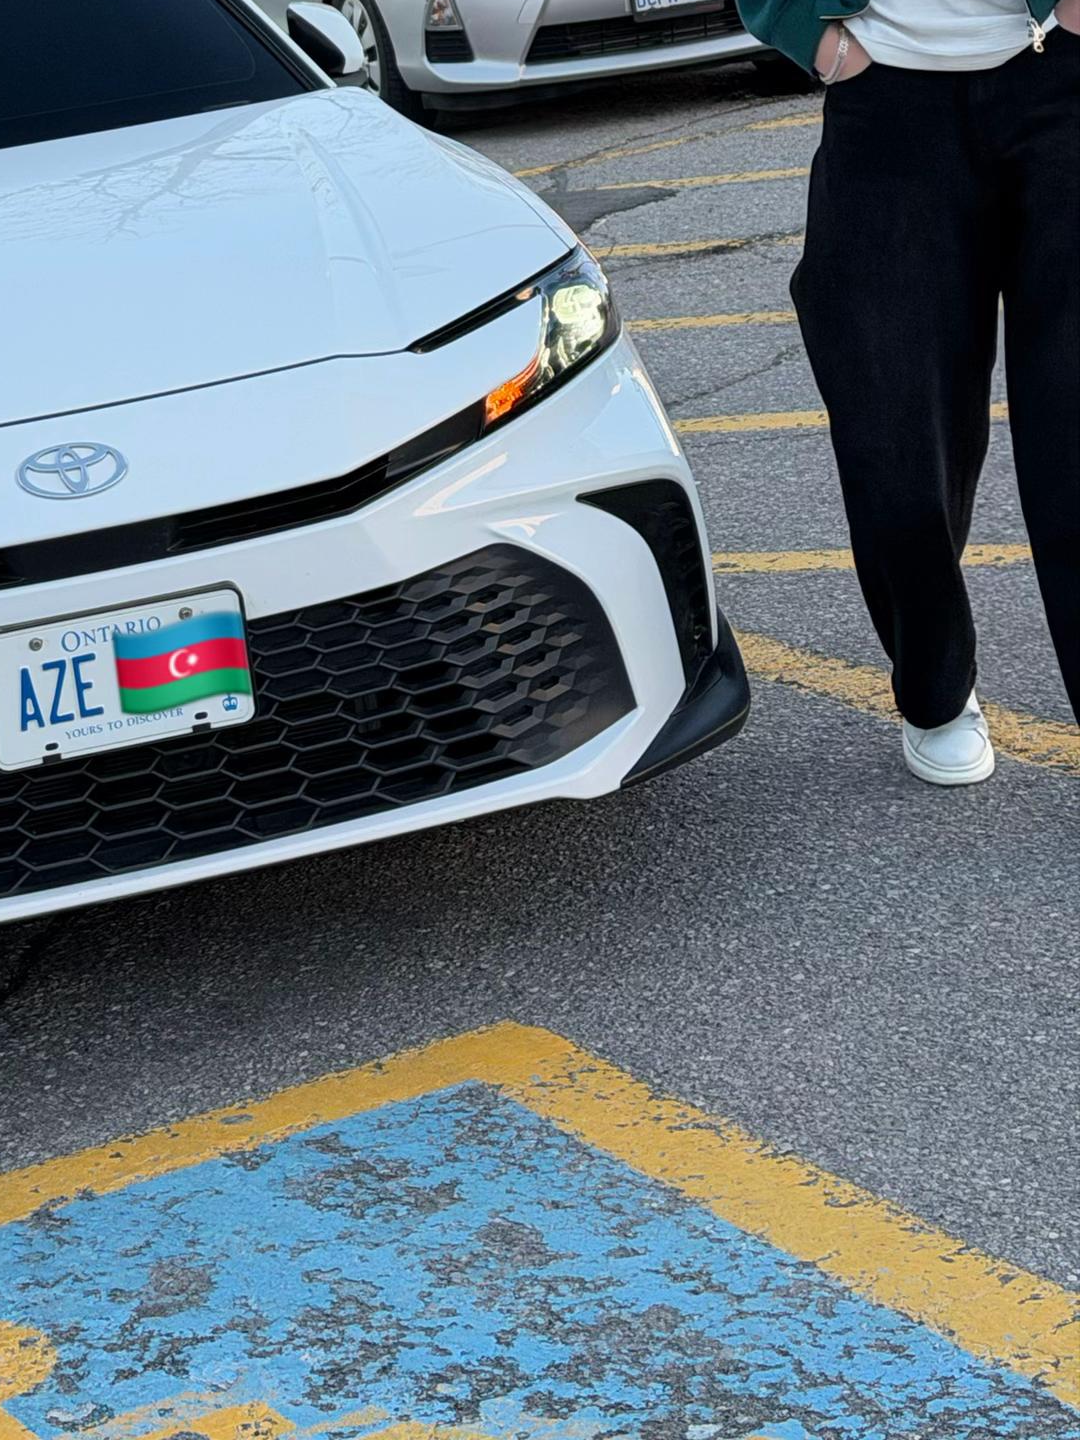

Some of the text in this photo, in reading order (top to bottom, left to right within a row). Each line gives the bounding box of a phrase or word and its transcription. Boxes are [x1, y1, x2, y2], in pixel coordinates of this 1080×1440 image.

[20, 653, 104, 732] AZE
[65, 707, 184, 740] YOURS TO DISCOVER
